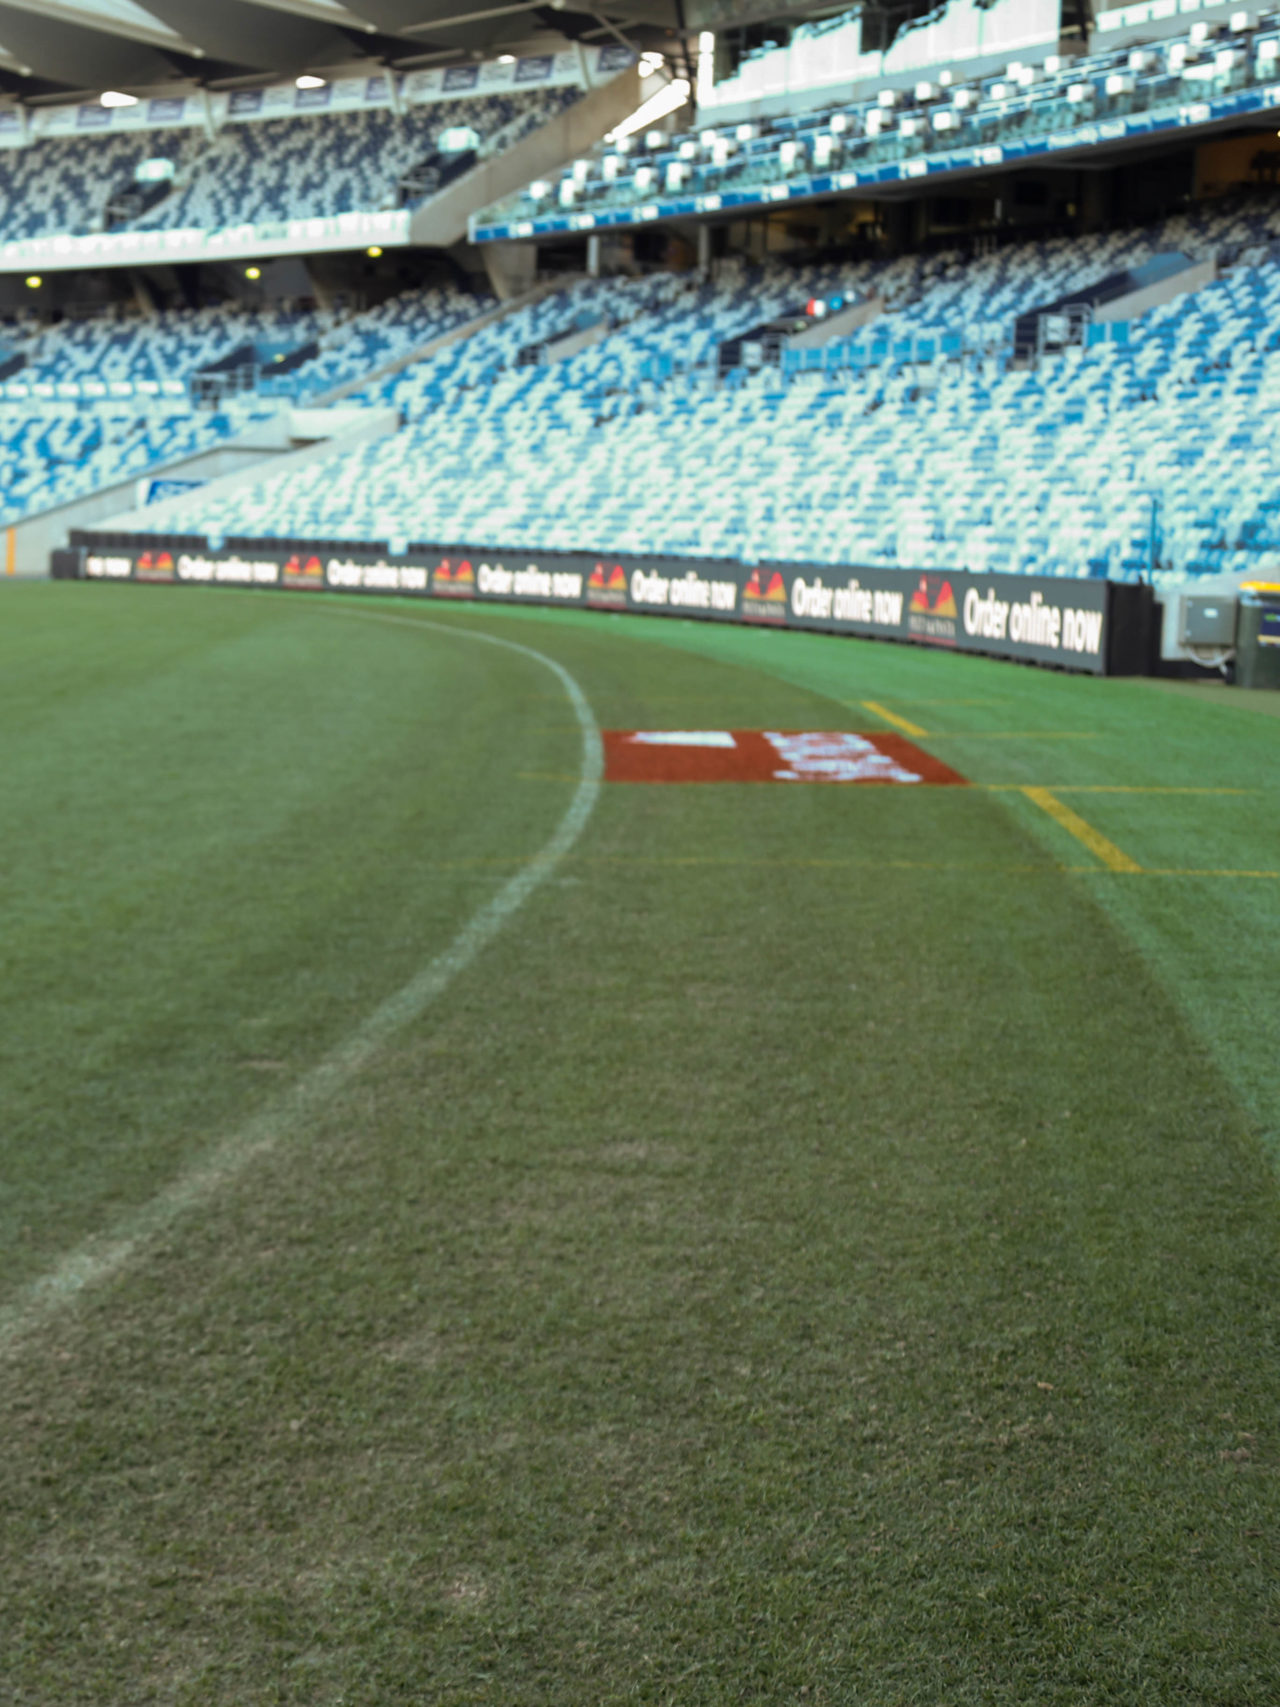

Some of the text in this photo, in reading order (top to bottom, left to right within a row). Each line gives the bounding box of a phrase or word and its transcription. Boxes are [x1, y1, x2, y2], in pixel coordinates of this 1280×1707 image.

[177, 553, 215, 581] Order
[252, 561, 279, 584] now
[326, 558, 362, 587] Order
[400, 565, 428, 590] now
[477, 562, 513, 595] Order
[552, 571, 583, 599] now
[630, 568, 669, 605] Order
[669, 570, 710, 609] online
[710, 580, 737, 611] now
[791, 577, 832, 619] Order
[833, 578, 872, 623] online
[872, 589, 904, 626] now
[963, 587, 1009, 640] Order
[1009, 591, 1061, 648] online
[1062, 607, 1103, 655] now
